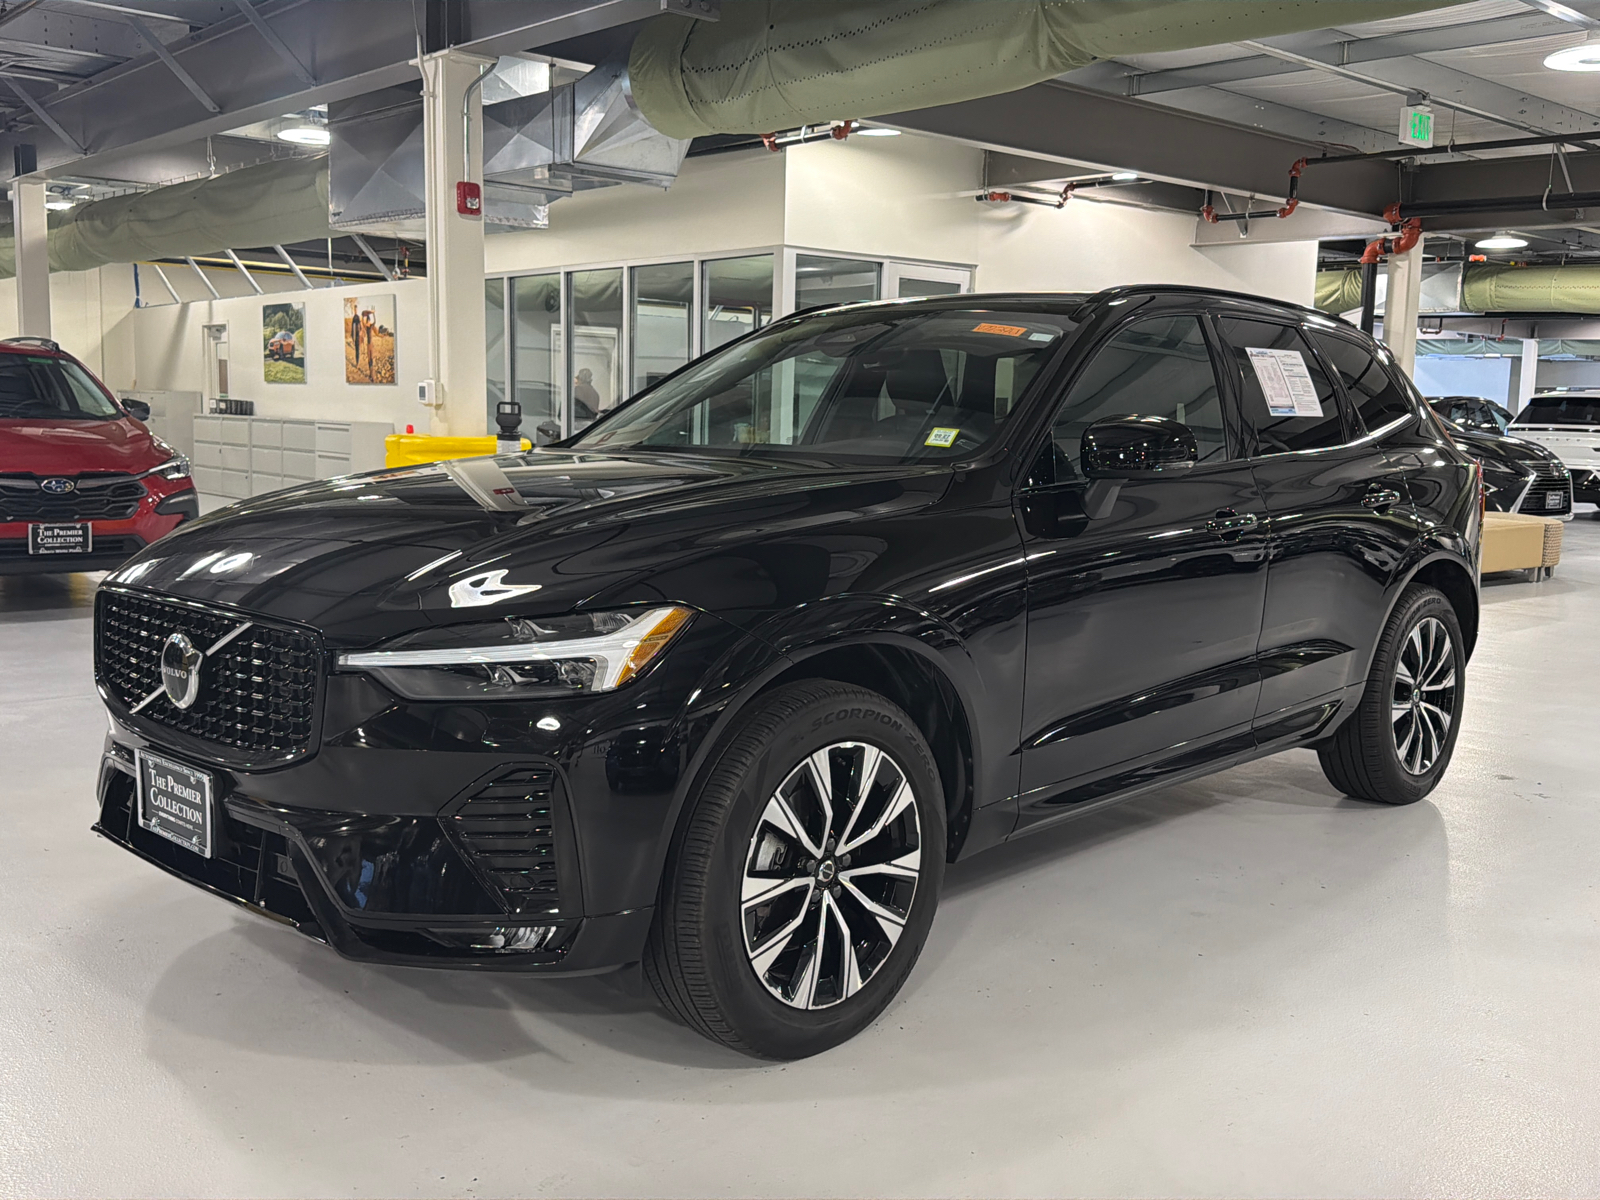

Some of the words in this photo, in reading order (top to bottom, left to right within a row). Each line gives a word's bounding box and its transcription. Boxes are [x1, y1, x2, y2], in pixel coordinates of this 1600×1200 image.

[1411, 112, 1430, 141] EXIT
[38, 536, 83, 544] COLLECTION
[54, 528, 83, 536] PREMIER
[1423, 597, 1442, 607] ZERO
[163, 666, 187, 679] VOLVO
[810, 707, 903, 732] SCORPION
[904, 731, 936, 782] ZERO
[148, 768, 167, 790] THE
[167, 775, 202, 805] PREMIER
[150, 787, 203, 825] COLLECTION
